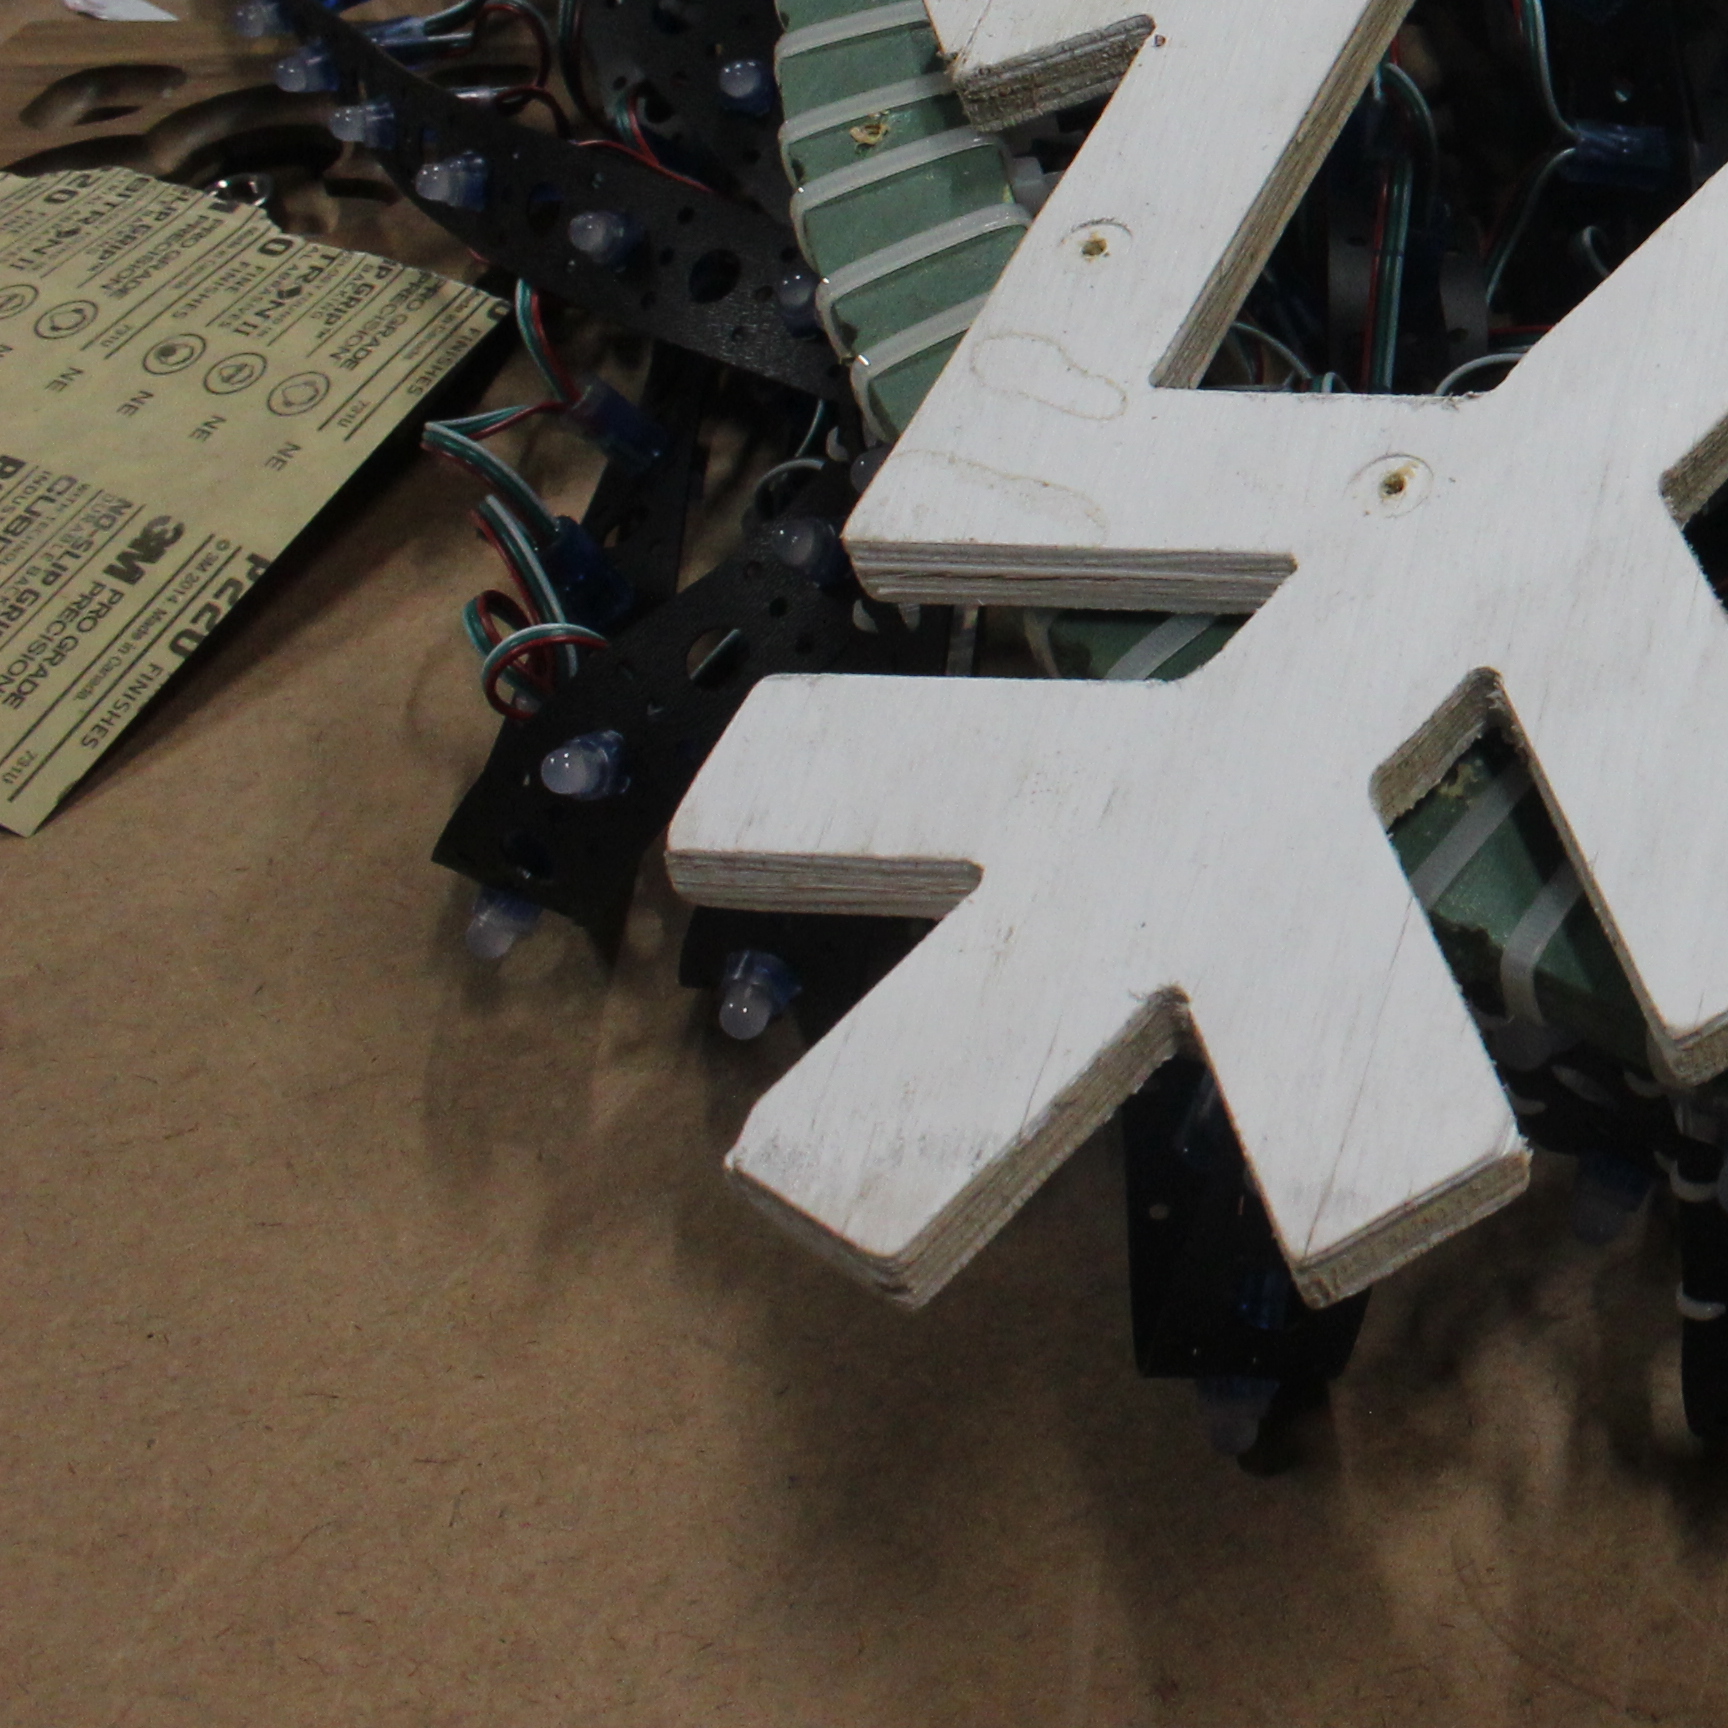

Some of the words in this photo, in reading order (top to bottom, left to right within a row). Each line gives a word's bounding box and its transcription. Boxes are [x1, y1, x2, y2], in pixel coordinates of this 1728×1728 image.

[100, 215, 209, 290] PRECISION
[181, 219, 224, 248] PRO
[107, 250, 182, 299] GRADE
[172, 262, 251, 318] FINISHES
[405, 275, 447, 312] PRO
[329, 271, 434, 361] PRECISION
[339, 315, 409, 372] GRADE
[407, 328, 483, 397] FINISHES
[45, 366, 85, 393] NE
[116, 390, 154, 417] NE
[337, 400, 371, 429] 731U
[188, 415, 227, 443] NE
[265, 441, 301, 471] NE
[41, 498, 134, 587] NO-SLIP
[103, 515, 185, 585] 3M
[196, 552, 219, 573] 3M
[76, 588, 125, 633] PRO
[131, 608, 168, 640] Made
[0, 580, 107, 695] PRECISION
[118, 641, 137, 656] in
[4, 635, 79, 710] GRADE
[81, 663, 164, 749] FINISHES
[2, 750, 39, 785] 731U
